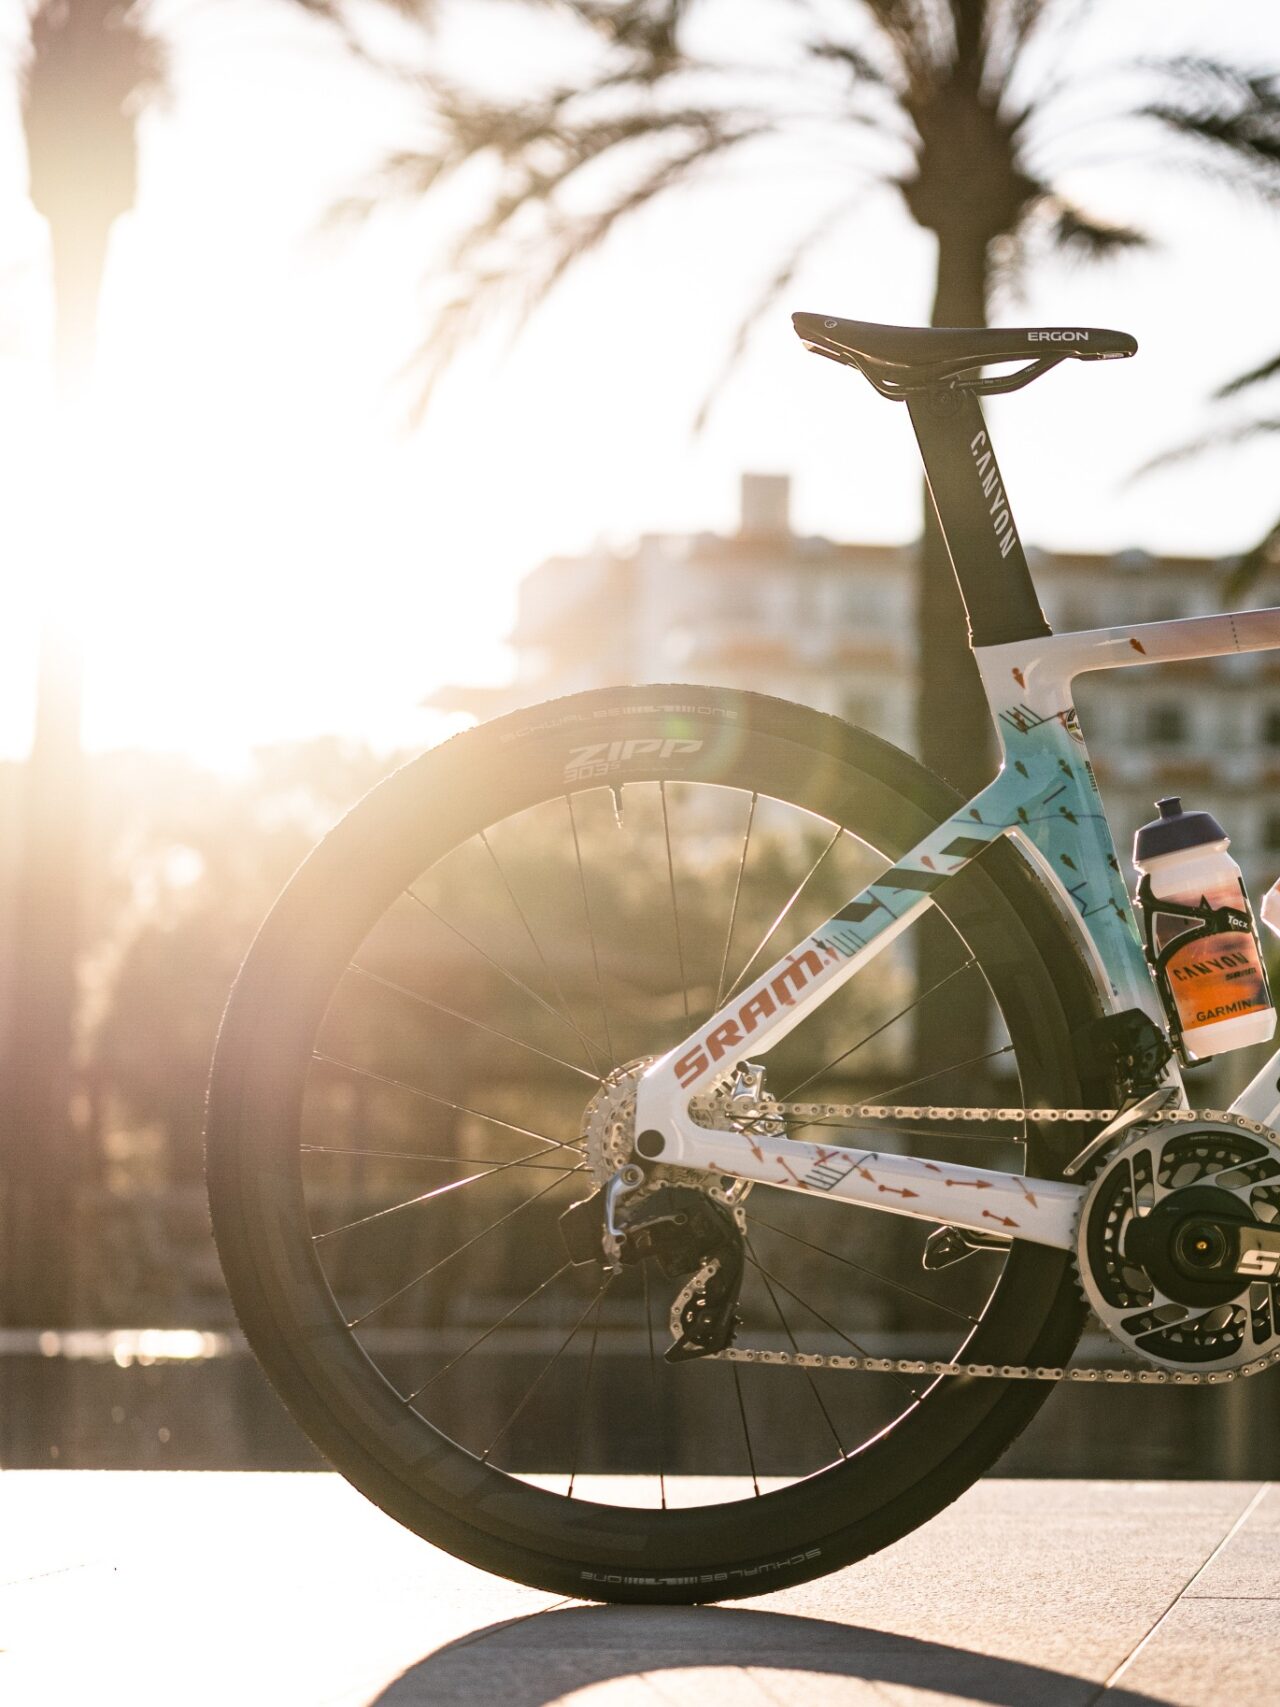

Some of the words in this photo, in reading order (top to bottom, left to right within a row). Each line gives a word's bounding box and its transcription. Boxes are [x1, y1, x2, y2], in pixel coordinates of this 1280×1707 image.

[1027, 331, 1089, 342] ERGON
[970, 429, 1017, 559] CANYON
[499, 707, 622, 742] SCHWALBE
[696, 707, 739, 719] ONE
[565, 738, 704, 770] ZIPP
[1227, 915, 1249, 930] Tacx
[1173, 952, 1250, 983] CANYON
[673, 949, 827, 1090] SRAM
[1196, 999, 1253, 1024] GARMIN
[700, 1547, 822, 1582] SCHWALBE
